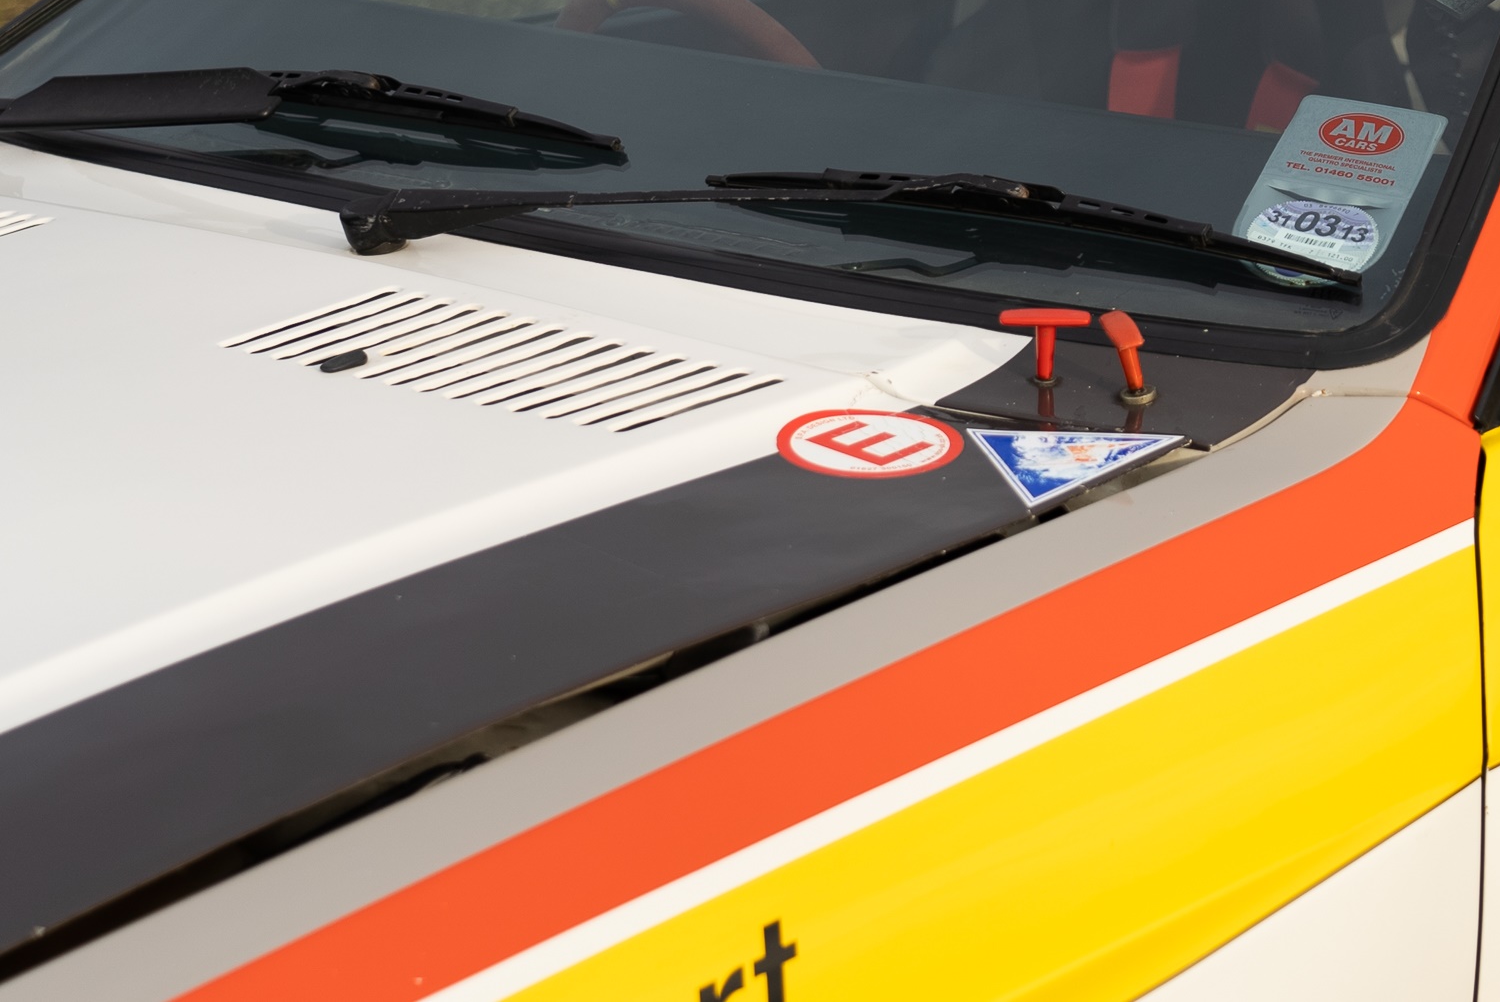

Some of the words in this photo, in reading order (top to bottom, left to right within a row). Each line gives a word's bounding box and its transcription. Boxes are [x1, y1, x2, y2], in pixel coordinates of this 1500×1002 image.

[1329, 118, 1394, 145] AM
[1334, 137, 1379, 152] CARS
[1300, 149, 1313, 157] THE
[1313, 152, 1344, 162] PREMIER
[1344, 156, 1396, 171] INTERNATIONAL
[1308, 156, 1340, 167] QUATTRO
[1341, 162, 1383, 174] SPECIALISTS
[1286, 161, 1310, 172] TEL.
[1315, 166, 1354, 179] 01460
[1356, 173, 1396, 186] 55001
[1267, 209, 1292, 227] 31
[1294, 210, 1342, 237] 03
[1341, 224, 1370, 243] 13
[805, 420, 935, 466] E
